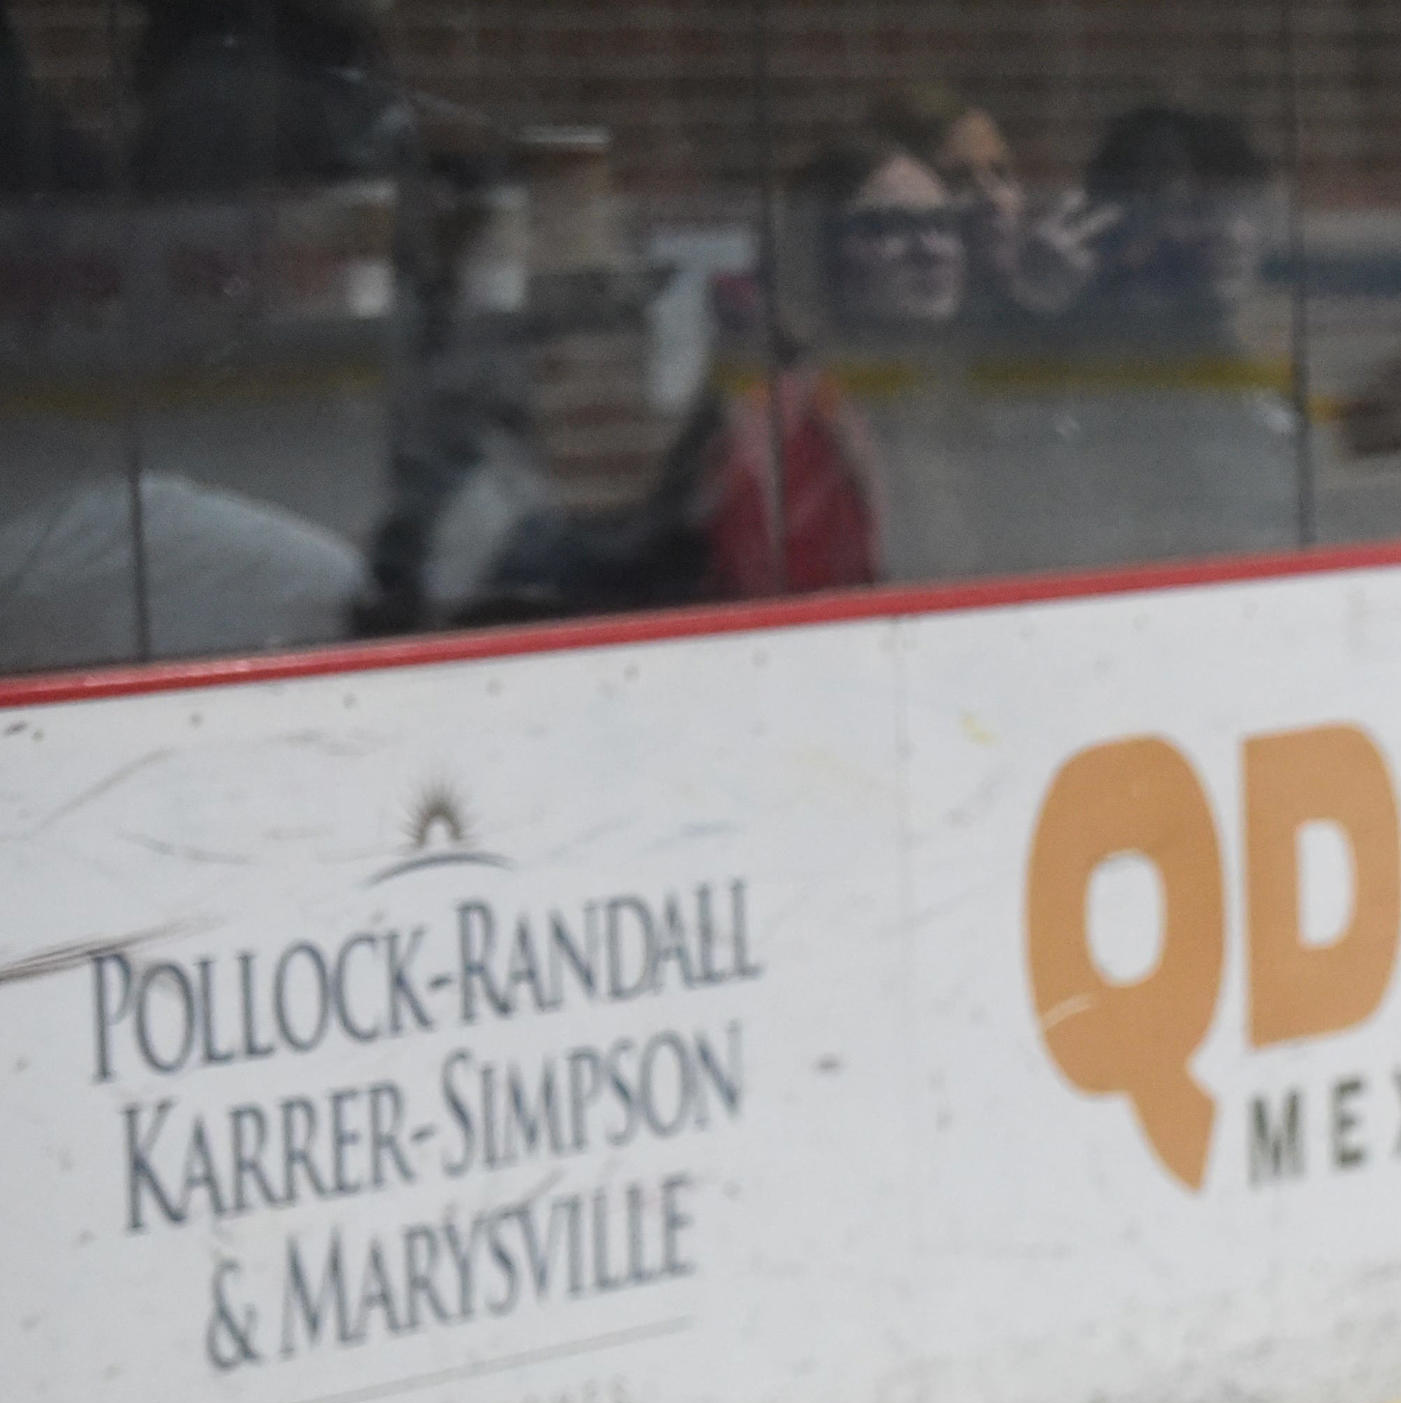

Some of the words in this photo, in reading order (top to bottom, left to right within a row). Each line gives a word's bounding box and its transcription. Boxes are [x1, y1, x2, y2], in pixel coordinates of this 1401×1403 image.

[90, 878, 763, 1084] POLLOCK-RANDALL
[122, 1022, 743, 1235] KARRER-SIMPSON
[206, 1258, 262, 1373] &
[279, 1172, 697, 1360] MARYSVILLE
